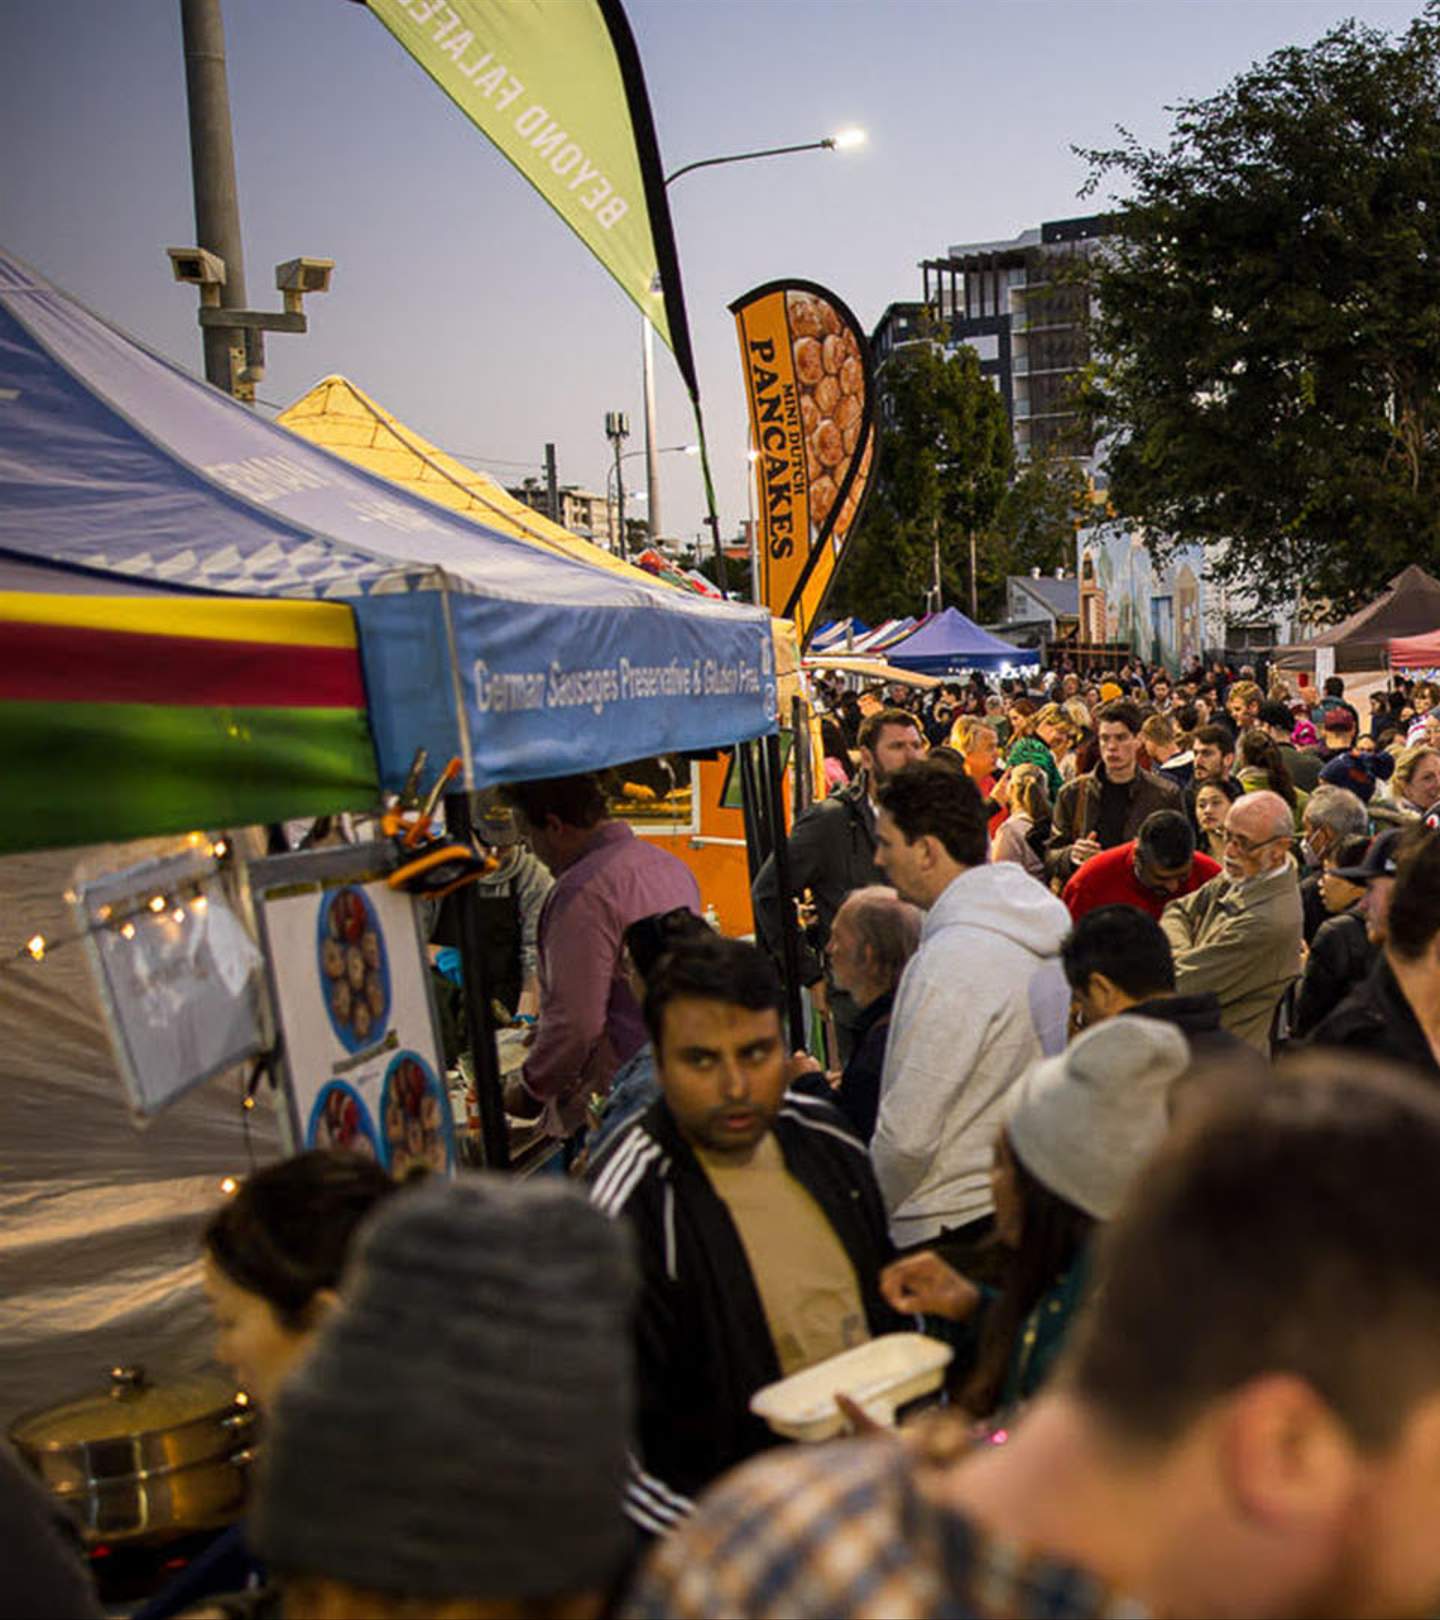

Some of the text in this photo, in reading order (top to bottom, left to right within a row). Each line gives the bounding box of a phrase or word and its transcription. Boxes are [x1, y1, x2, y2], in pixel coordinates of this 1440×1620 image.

[750, 338, 795, 561] PANCAKES
[781, 383, 807, 496] MINI DUTCH
[473, 659, 545, 712] German
[547, 660, 618, 715] Sausages
[619, 656, 692, 700] Preservative
